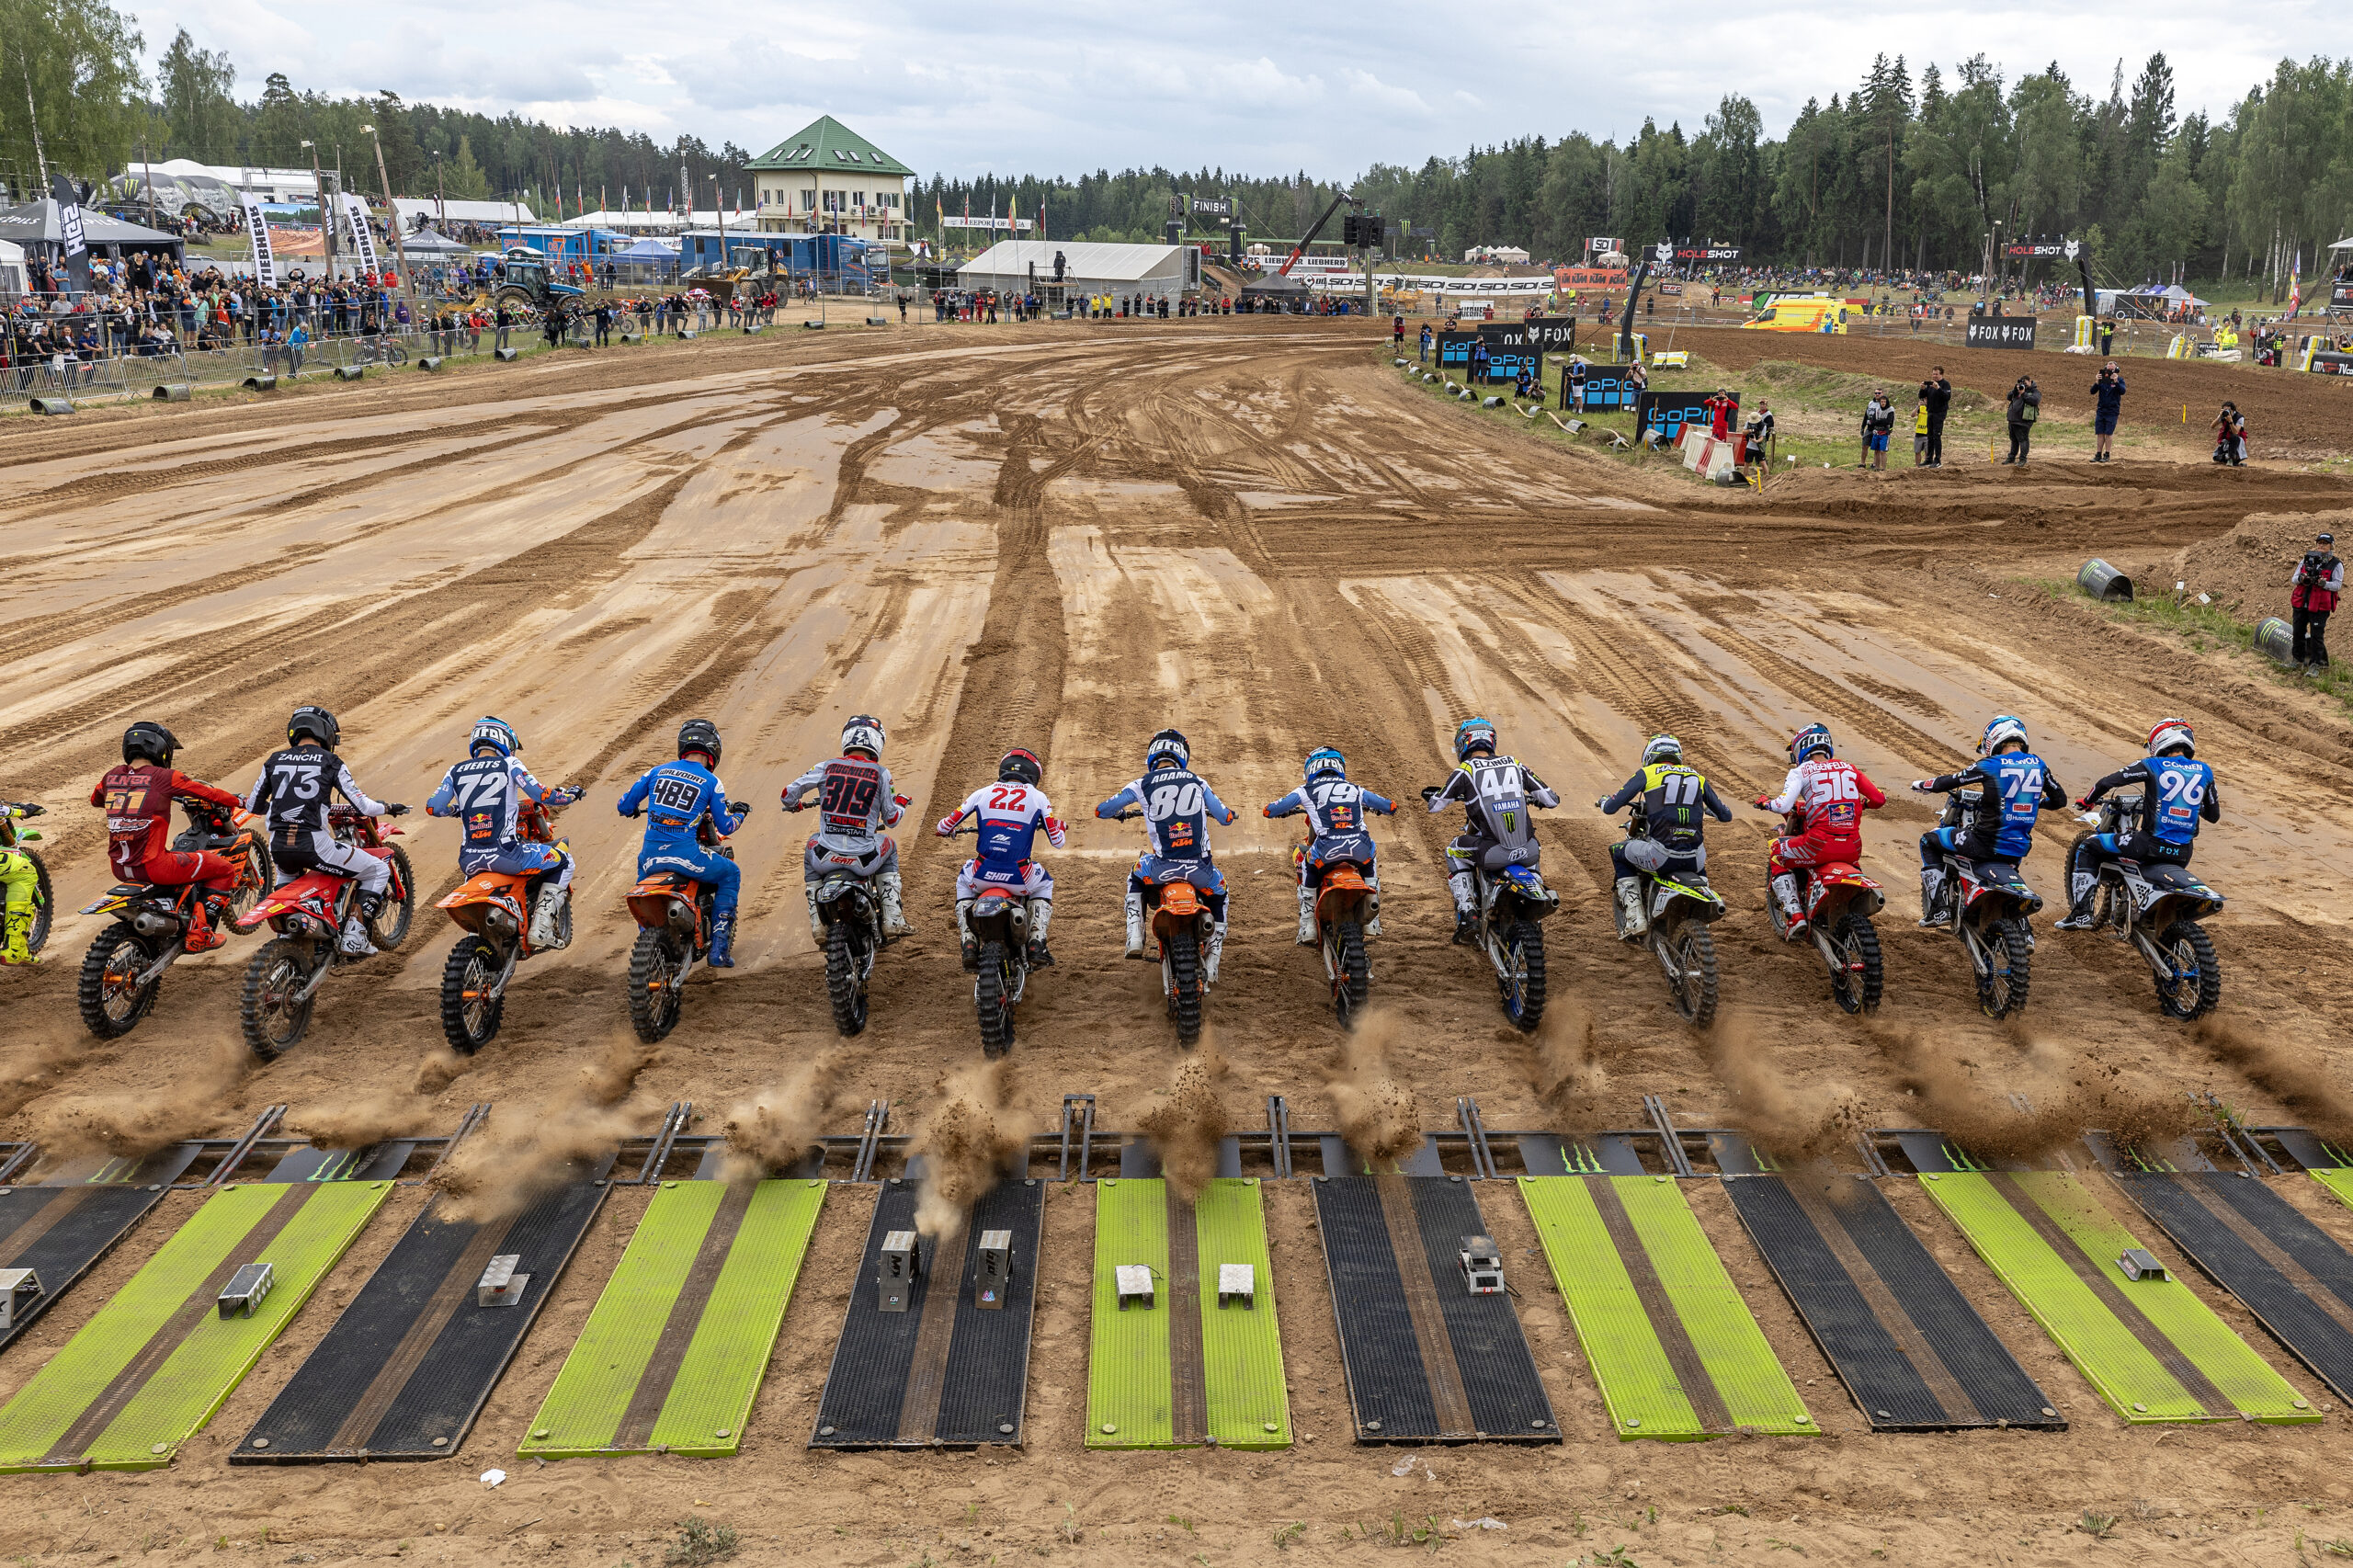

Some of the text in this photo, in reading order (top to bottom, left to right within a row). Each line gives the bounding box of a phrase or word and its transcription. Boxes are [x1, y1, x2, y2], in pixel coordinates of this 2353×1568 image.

[1194, 201, 1226, 212] FINISH
[1677, 249, 1738, 259] HOLESHOT
[2008, 245, 2061, 256] HOLESHOT
[1504, 328, 1572, 345] OX FOX
[1979, 326, 2032, 341] FOX FOX
[1487, 355, 1535, 366] oPro
[1579, 378, 1634, 391] oPro
[1648, 407, 1714, 422] GoPr
[278, 754, 323, 762] ZANCHI
[1473, 756, 1515, 768] ELZINGA
[457, 760, 501, 772] EVERTS
[273, 765, 321, 800] 73
[659, 768, 706, 784] WALVOORT
[1151, 771, 1194, 784] ADAMO
[1481, 767, 1522, 801] 44
[1663, 774, 1699, 806] 11
[1810, 770, 1859, 805] 516
[2000, 768, 2043, 799] 74
[2159, 770, 2204, 805] 96
[457, 772, 508, 811] 72
[654, 778, 700, 812] 489
[822, 775, 878, 817] 319
[1312, 783, 1359, 810] 19
[105, 787, 150, 816] 51
[989, 788, 1027, 812] 22
[1149, 783, 1202, 822] 80
[1494, 801, 1520, 811] YAMAHA
[472, 830, 492, 839] KTM
[1171, 838, 1193, 847] KTM
[2159, 846, 2179, 856] FOX
[831, 856, 858, 865] LEATT
[316, 863, 344, 876] HONDA
[983, 871, 1015, 882] SHOT
[205, 901, 219, 910] FOX
[363, 903, 374, 913] FOX
